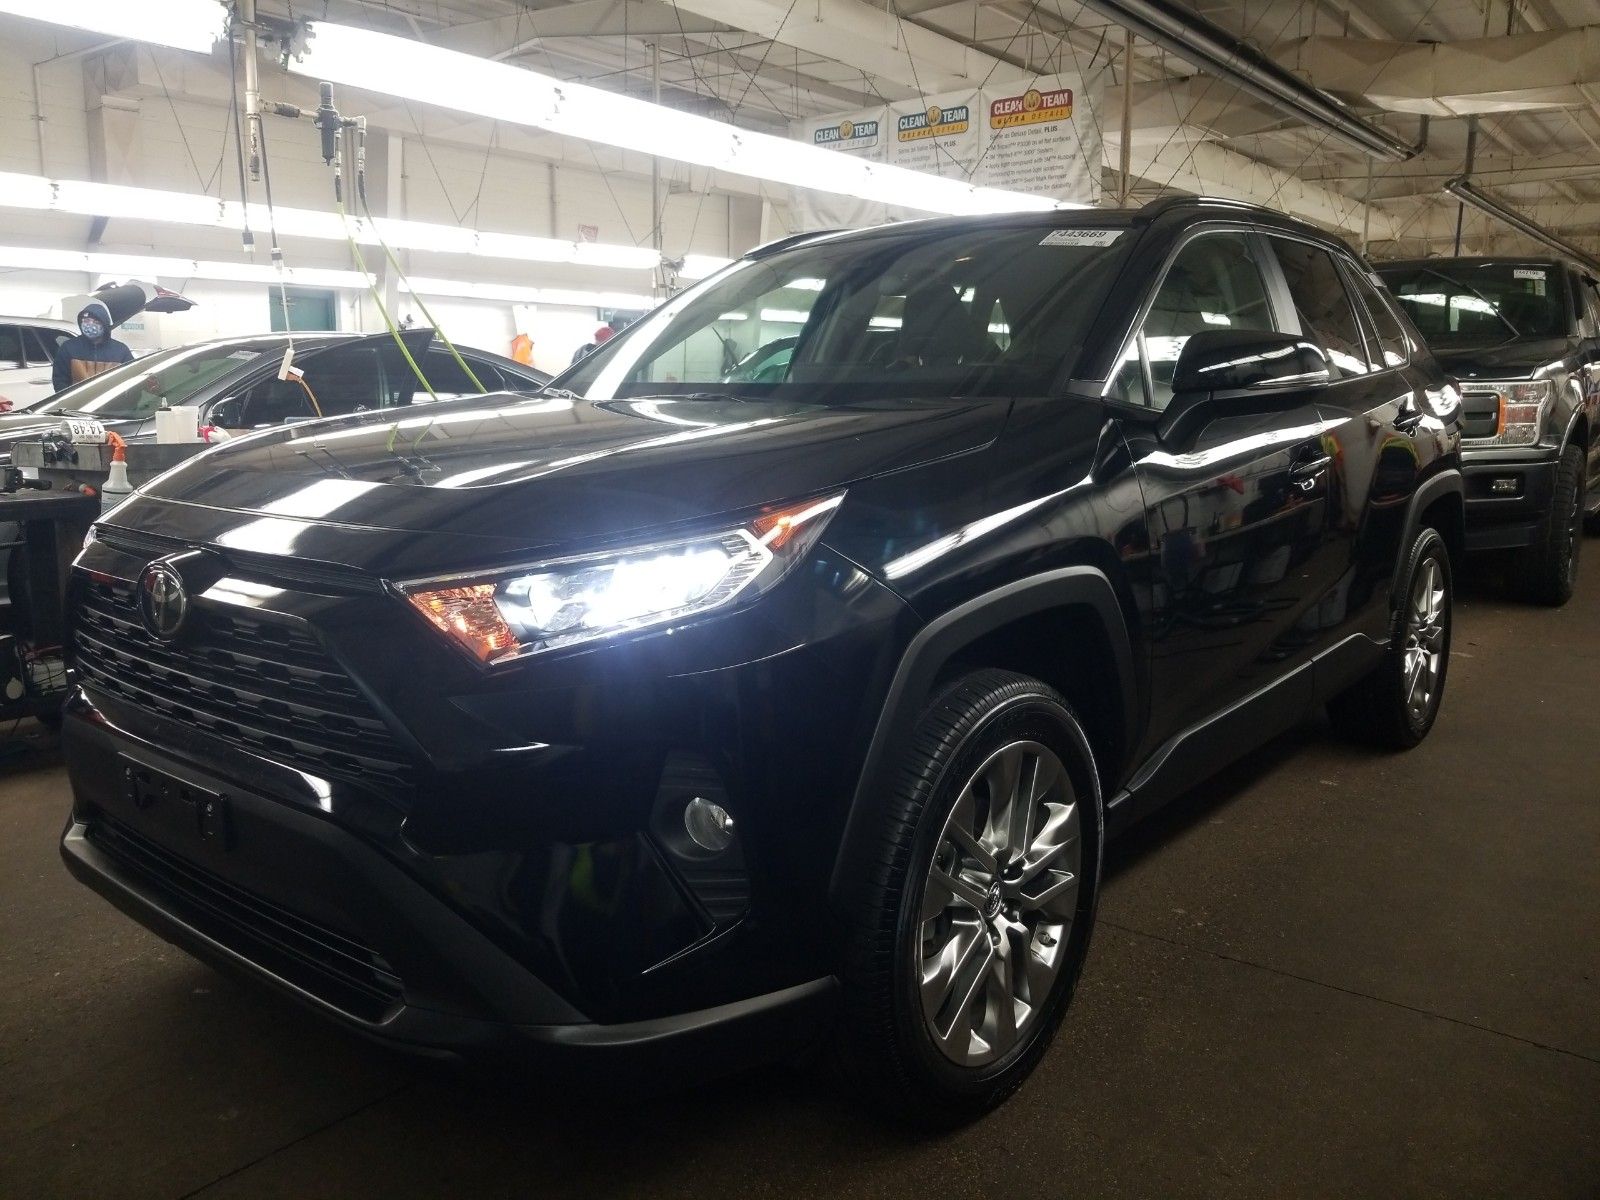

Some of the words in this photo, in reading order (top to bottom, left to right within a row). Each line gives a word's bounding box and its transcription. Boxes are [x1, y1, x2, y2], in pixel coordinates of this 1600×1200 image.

[994, 100, 1022, 114] CLEAN
[1042, 93, 1068, 107] TEAM
[900, 114, 925, 129] CLEAN
[943, 109, 966, 122] TEAM
[997, 115, 1025, 125] ULTRA
[1032, 110, 1063, 120] DETAIL
[816, 129, 838, 142] CLEAN
[854, 124, 876, 136] TEAM
